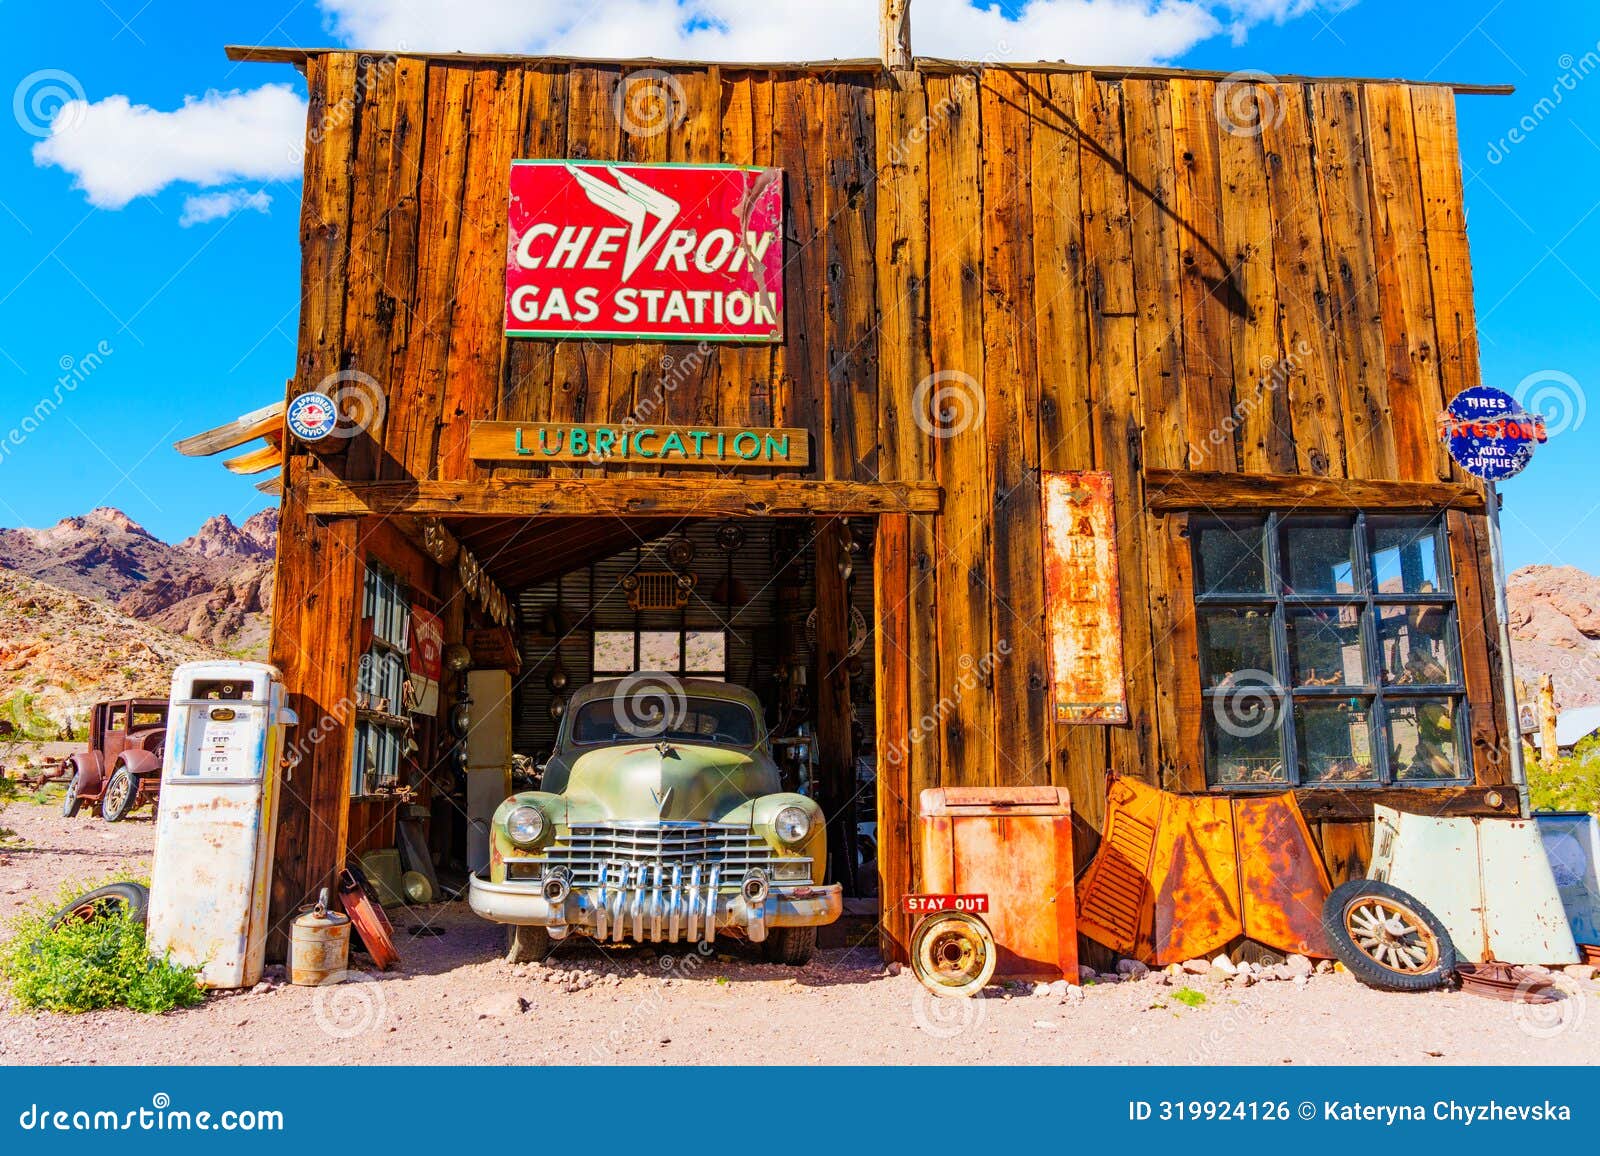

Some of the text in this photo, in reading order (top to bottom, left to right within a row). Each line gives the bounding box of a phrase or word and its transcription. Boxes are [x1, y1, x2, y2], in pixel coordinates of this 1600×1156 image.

[515, 216, 775, 283] CHEVRON
[510, 284, 776, 326] GAS STATION
[296, 395, 331, 412] APPROVED
[1465, 397, 1506, 409] TIRES
[293, 421, 328, 436] SERVICE
[515, 427, 789, 460] LUBRICATION
[1480, 447, 1506, 457] AUTO
[1467, 457, 1518, 469] SUPPLIES
[908, 897, 985, 911] STAY OUT
